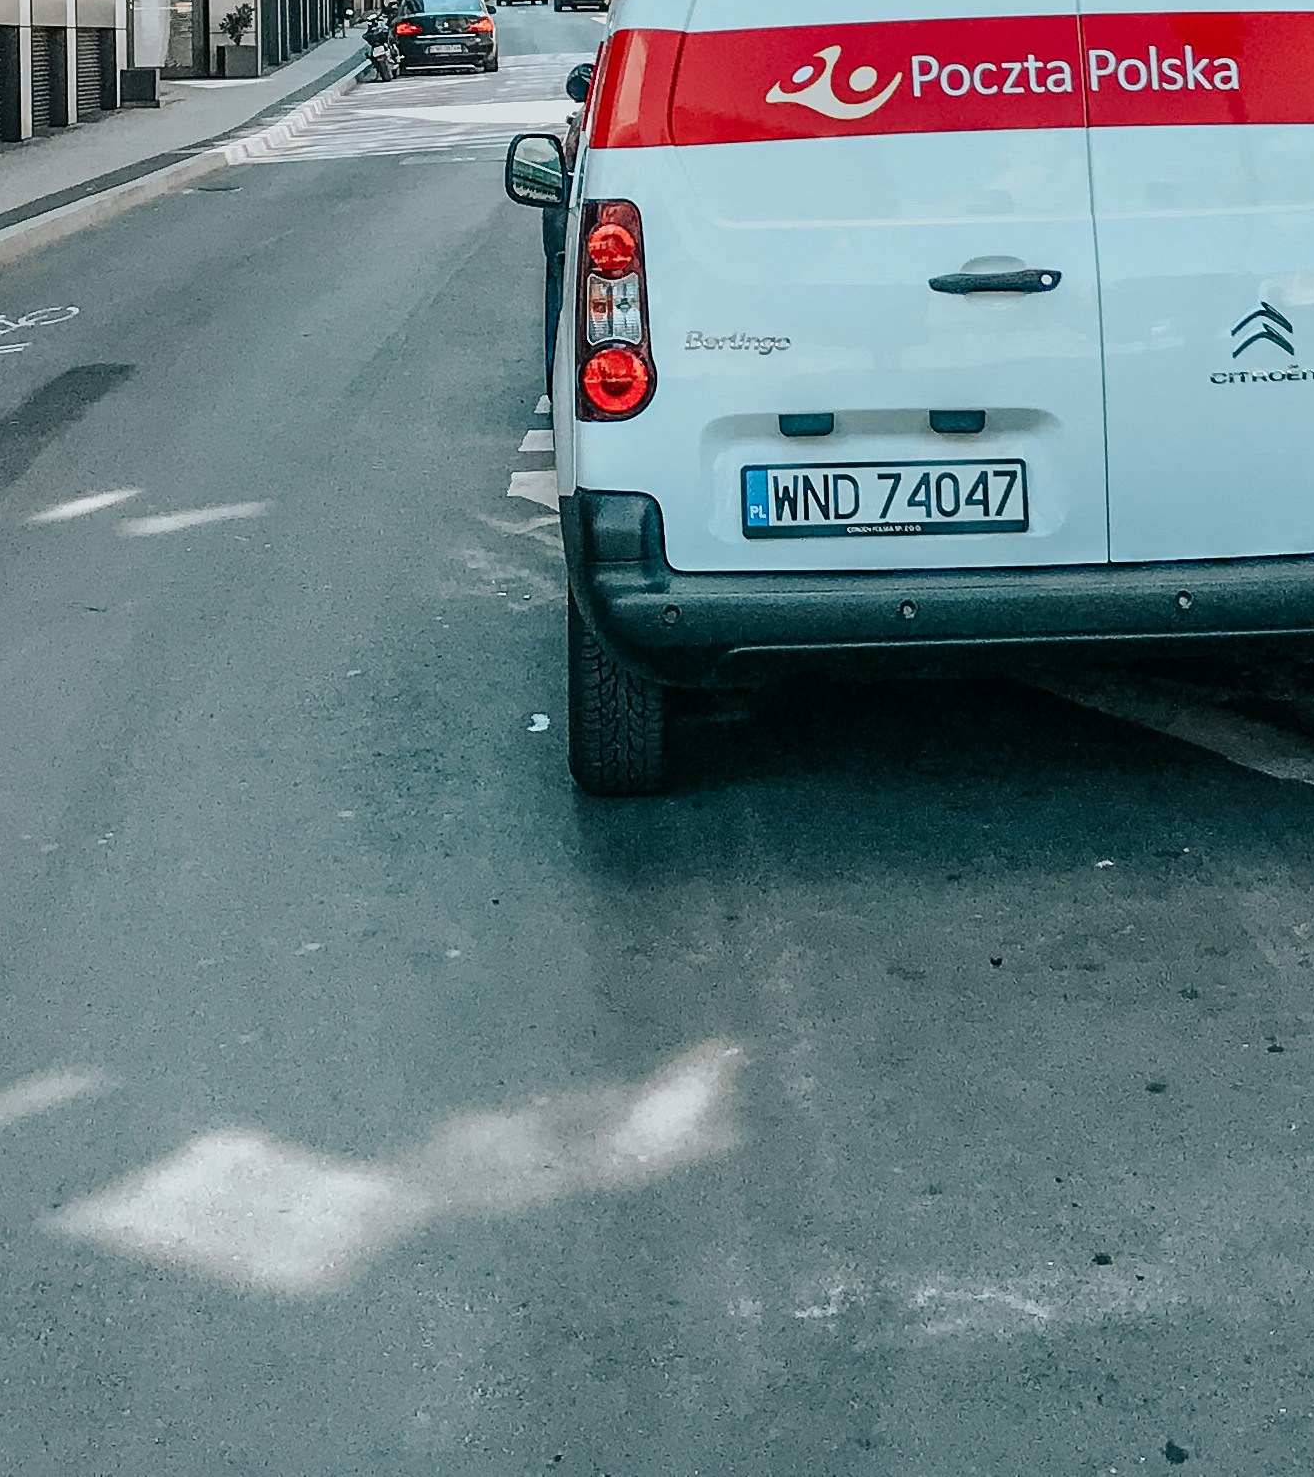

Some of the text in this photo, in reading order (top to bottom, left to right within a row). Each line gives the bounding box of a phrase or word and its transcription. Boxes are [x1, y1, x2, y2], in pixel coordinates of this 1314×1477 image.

[911, 44, 1240, 98] Poczta Polska
[684, 330, 792, 356] Berlingo
[749, 469, 1019, 522] PL WND 74047
